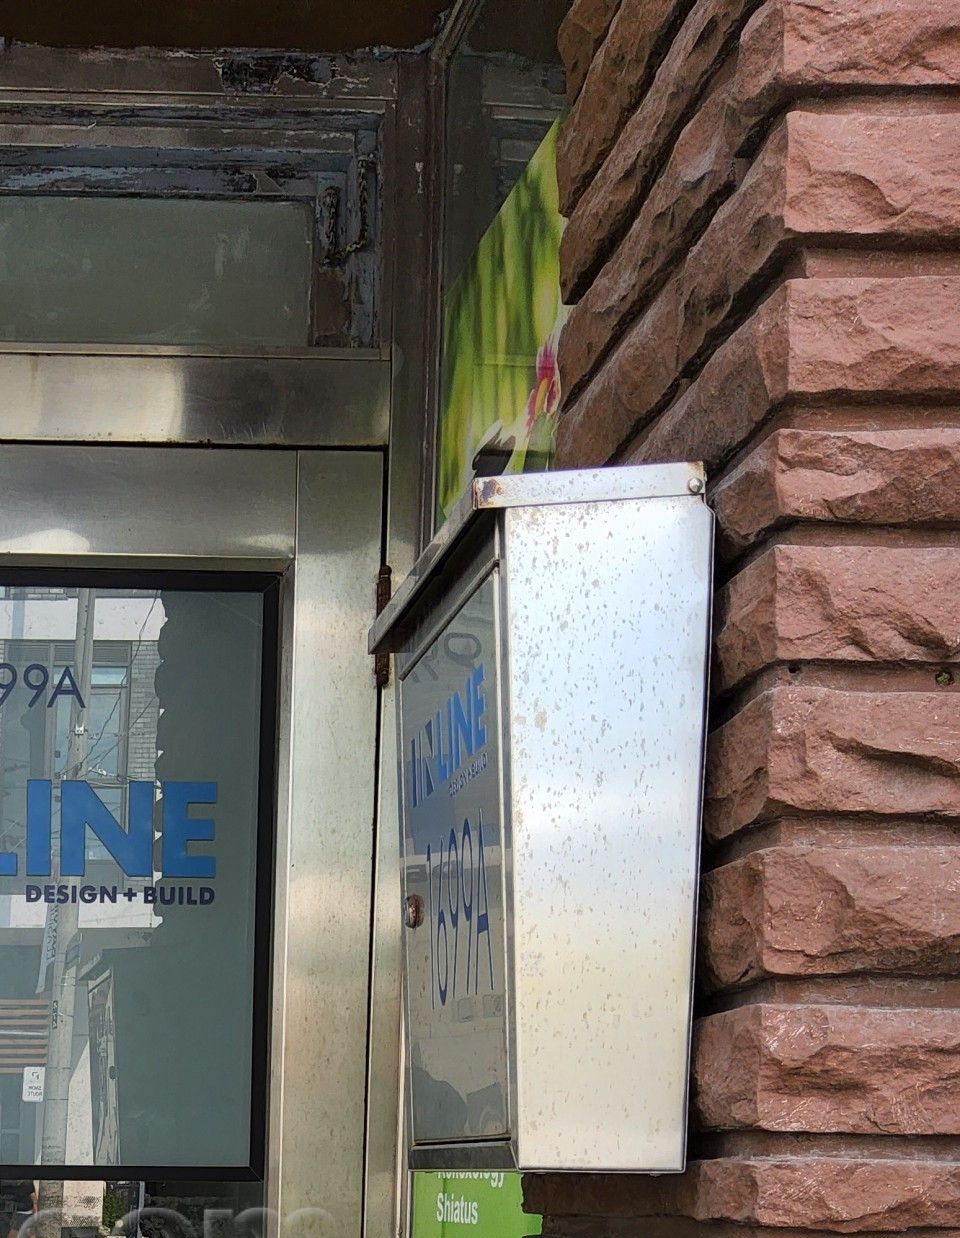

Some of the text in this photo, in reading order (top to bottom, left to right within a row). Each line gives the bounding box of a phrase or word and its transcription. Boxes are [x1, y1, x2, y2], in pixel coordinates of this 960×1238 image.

[410, 663, 488, 808] INLINE
[426, 808, 494, 1010] 1699A
[436, 1192, 478, 1225] Shiatus
